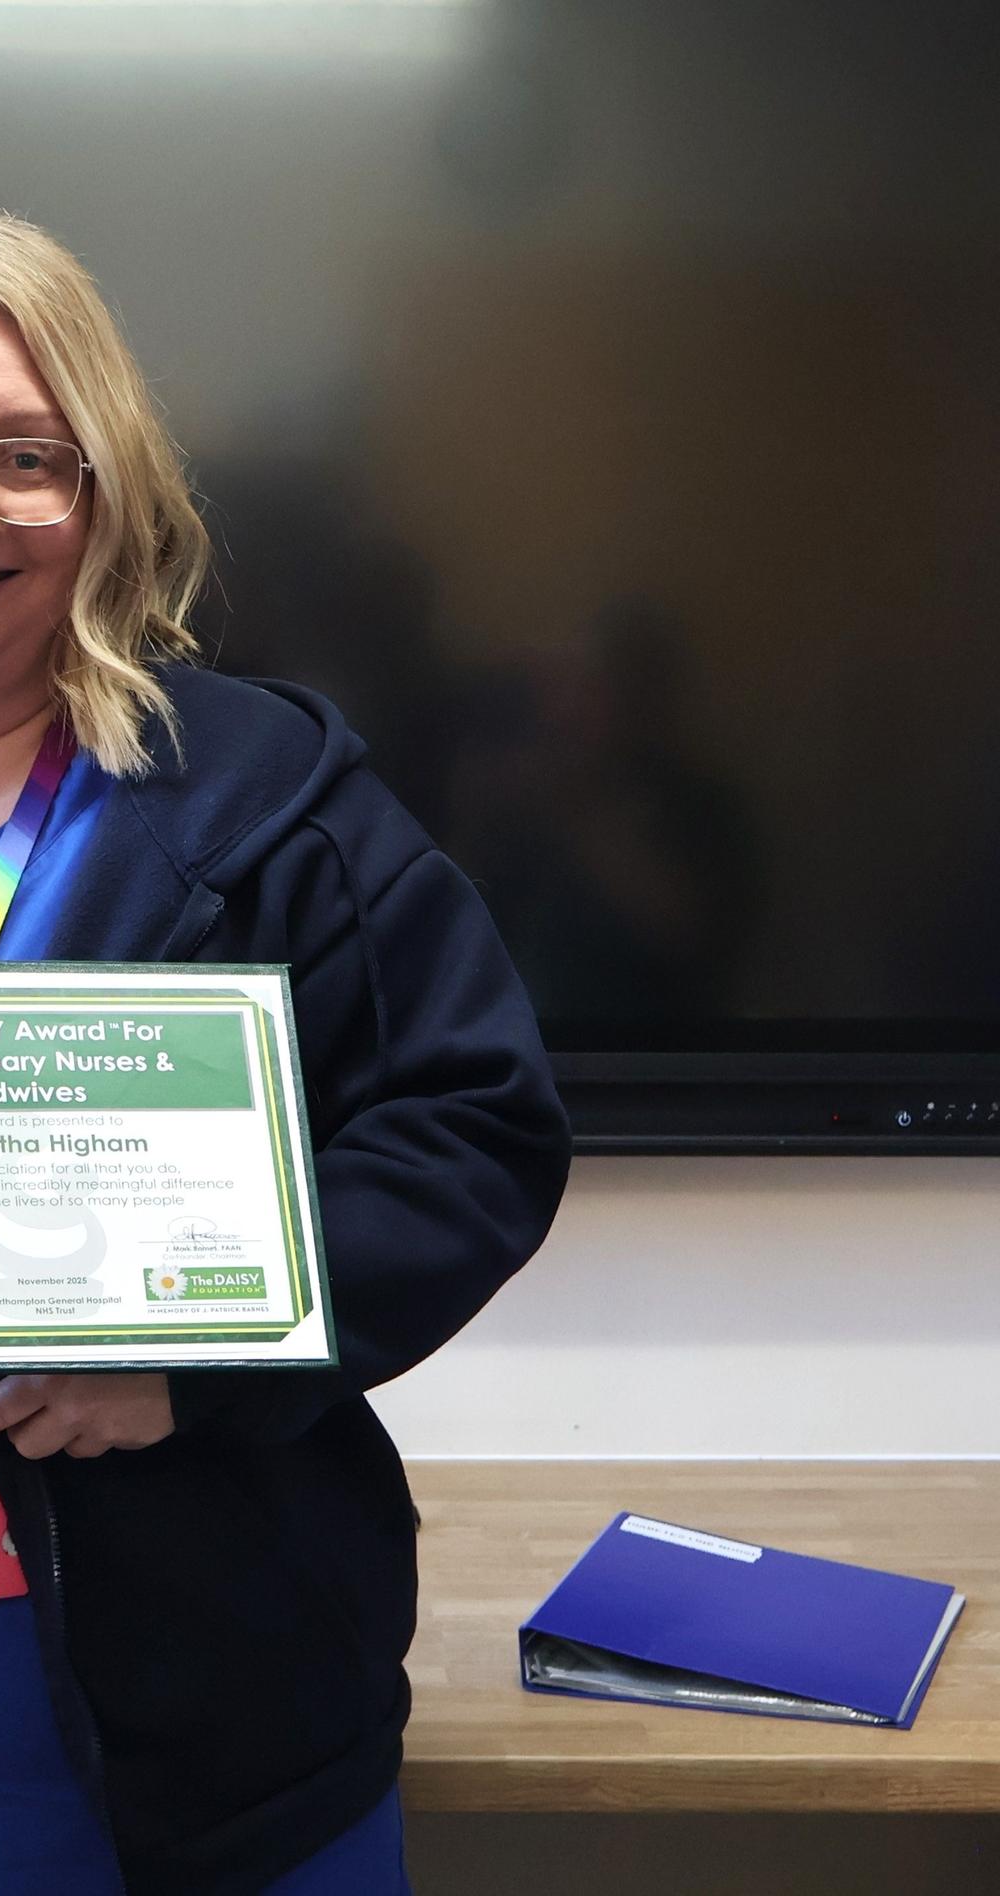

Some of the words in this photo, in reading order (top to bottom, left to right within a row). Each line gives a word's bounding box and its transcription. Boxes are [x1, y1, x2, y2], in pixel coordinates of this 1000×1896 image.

[123, 1021, 162, 1040] For
[56, 1051, 147, 1072] Nurses
[155, 1051, 174, 1072] &
[19, 1115, 29, 1126] is
[33, 1115, 104, 1129] presented
[109, 1115, 123, 1126] to
[50, 1134, 148, 1156] Higham
[51, 1164, 70, 1174] for
[75, 1163, 90, 1174] all
[94, 1163, 121, 1174] that
[126, 1165, 151, 1177] you
[157, 1163, 180, 1174] do,
[1, 1179, 71, 1193] incredibly
[76, 1179, 156, 1192] meaningful
[161, 1178, 234, 1189] difference
[15, 1196, 44, 1207] lives
[50, 1196, 65, 1206] of
[69, 1197, 83, 1206] so
[89, 1197, 127, 1209] many
[134, 1195, 184, 1208] people
